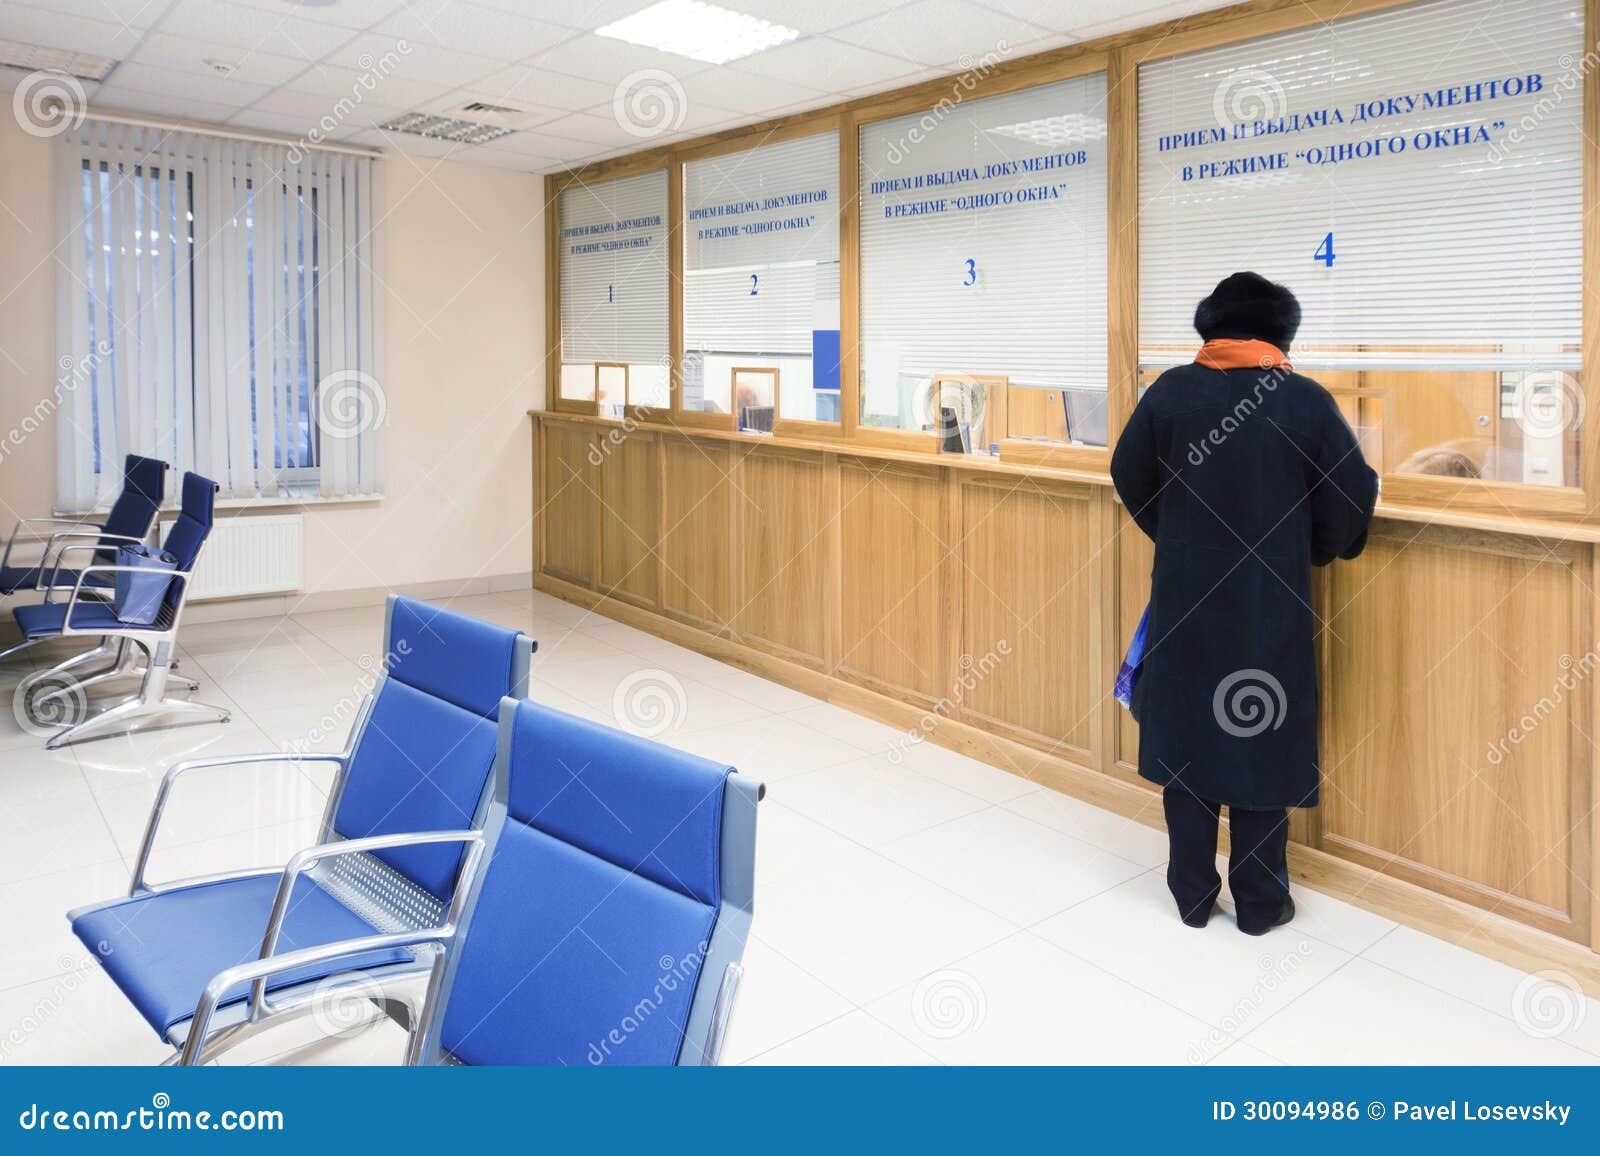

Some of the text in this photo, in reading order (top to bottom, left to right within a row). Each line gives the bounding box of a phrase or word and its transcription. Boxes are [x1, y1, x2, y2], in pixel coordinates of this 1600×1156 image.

[1158, 73, 1544, 152] ПРИЕМ И ВЫДАЧА ДОКУМЕНТОВ
[871, 150, 1087, 195] ПРИЕМ И ВЫДАЧА ДОКУМЕНТОВ
[1182, 165, 1194, 181] В
[1199, 153, 1289, 180] РЕЖИМЕ
[1295, 136, 1406, 166] “ОДНОГО
[689, 190, 828, 220] ПРИЕМ И ВЫДАЧА ДОКУМЕНТОВ
[884, 206, 893, 218] В
[894, 199, 948, 217] РЕЖИМЕ
[698, 229, 704, 240] В
[705, 226, 740, 239] РЕЖИМЕ
[1313, 232, 1336, 268] 4
[750, 274, 758, 296] 2
[963, 259, 976, 286] 3
[608, 284, 614, 304] 1
